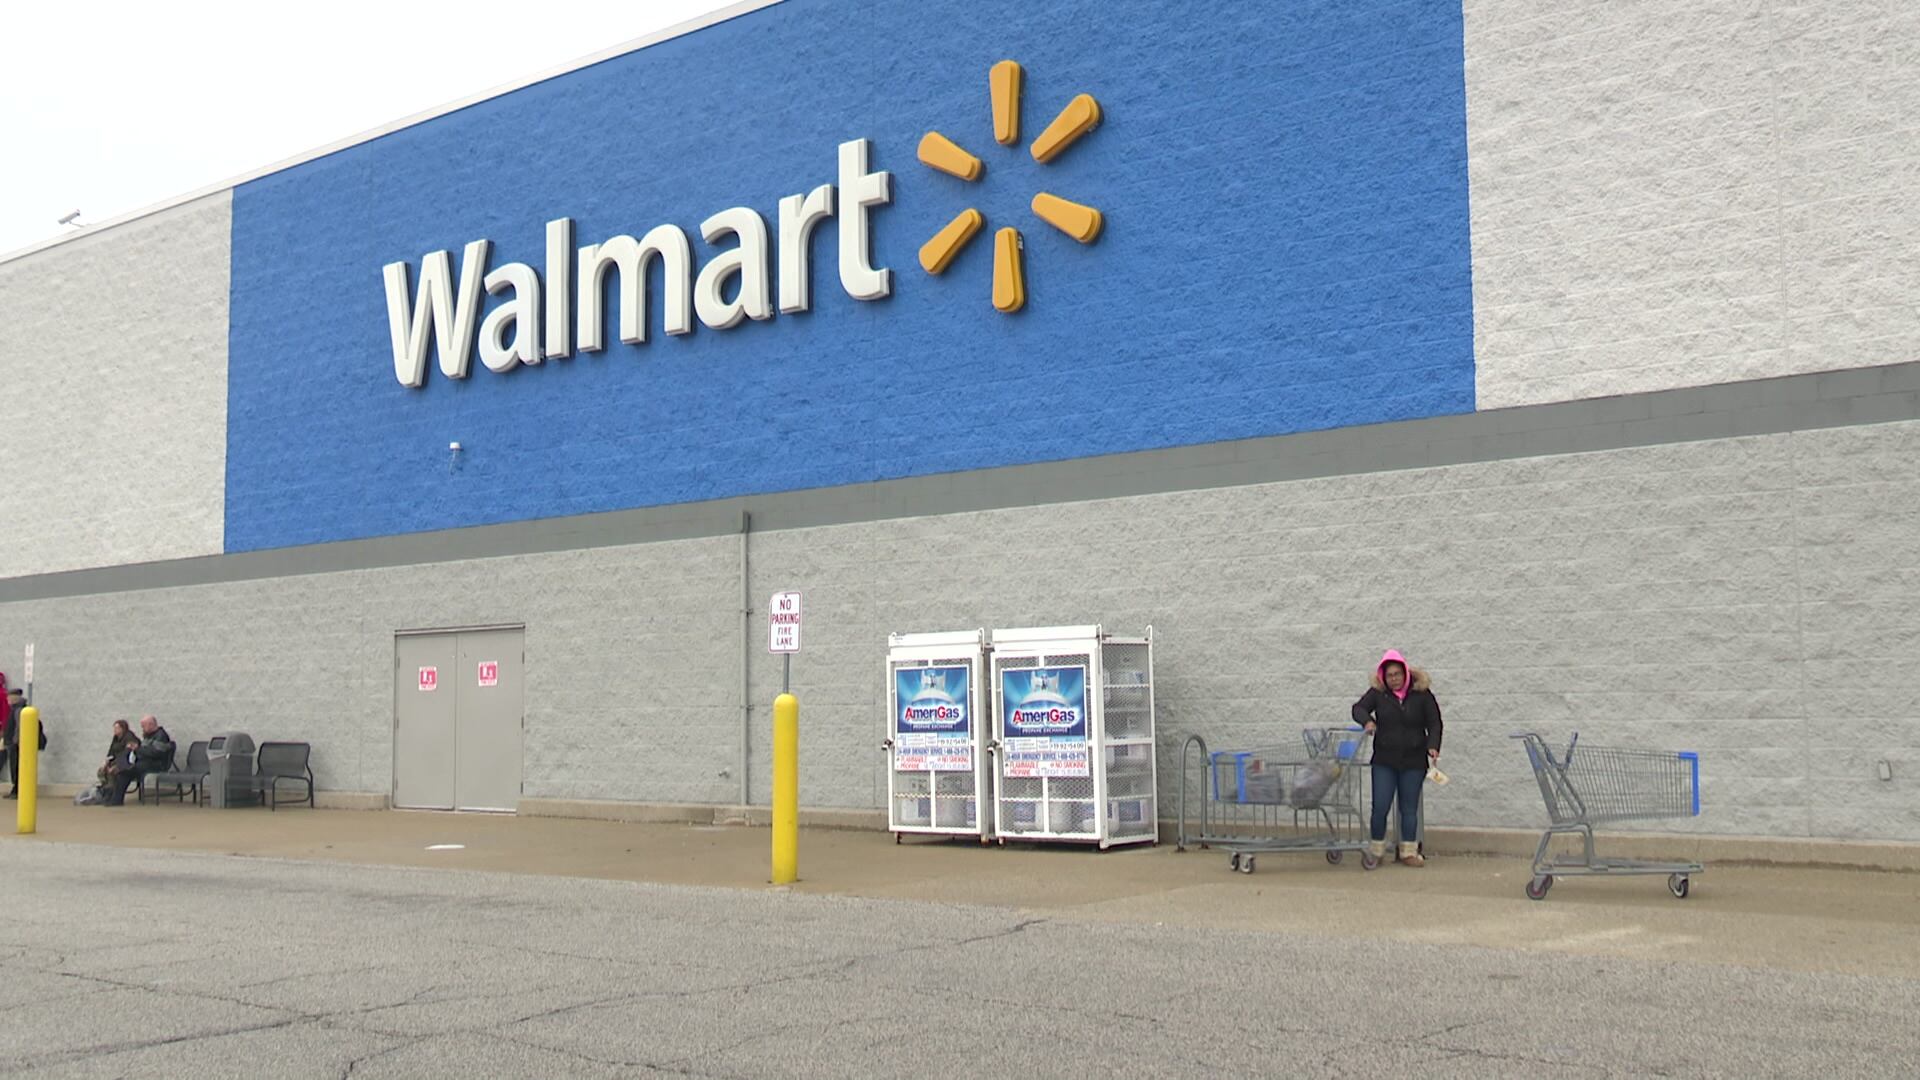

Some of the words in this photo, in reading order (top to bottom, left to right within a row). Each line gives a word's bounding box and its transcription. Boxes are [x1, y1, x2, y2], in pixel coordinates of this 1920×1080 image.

[383, 137, 891, 388] Walmart
[780, 599, 792, 610] NO
[771, 613, 799, 624] PARKING
[778, 627, 792, 635] FIRE
[776, 637, 792, 646] LANE
[905, 706, 960, 720] AmeriGas
[1013, 709, 1075, 723] AmeriGas
[1010, 761, 1039, 769] FLAMMABLE
